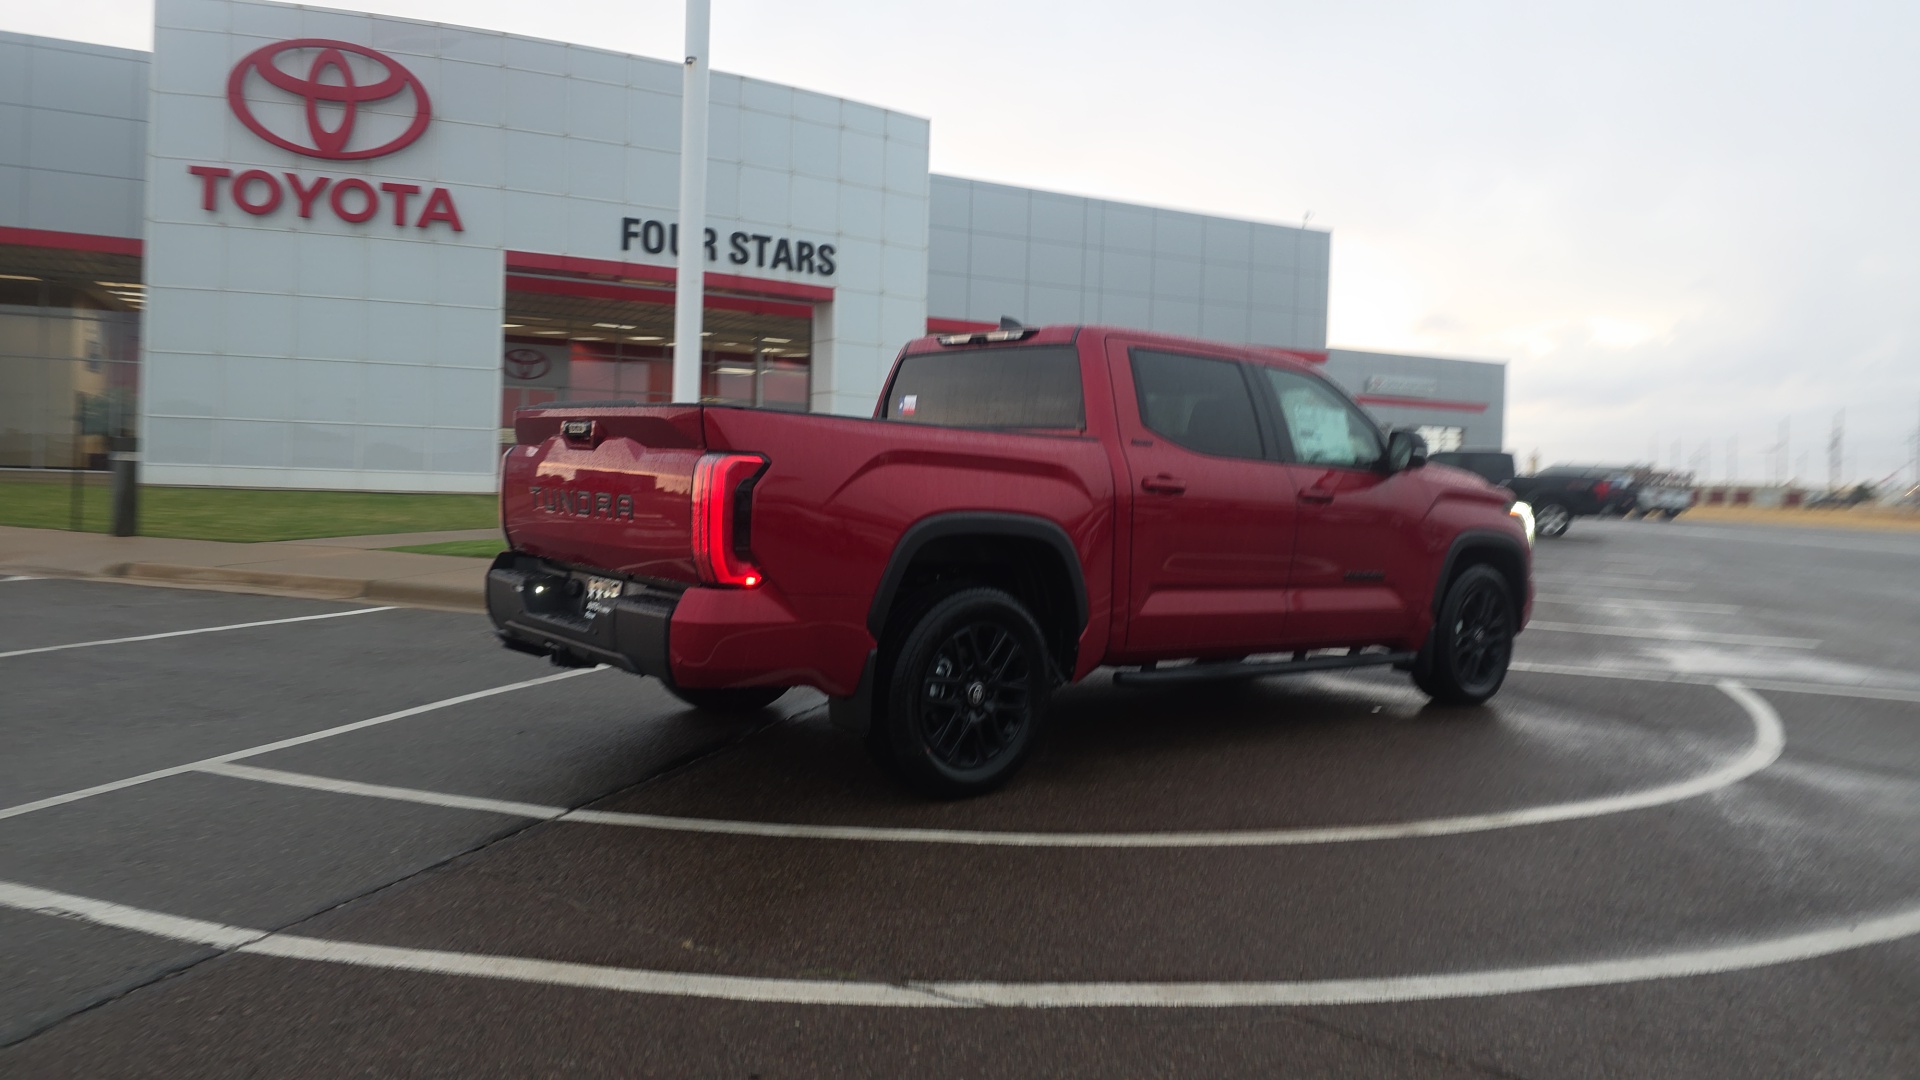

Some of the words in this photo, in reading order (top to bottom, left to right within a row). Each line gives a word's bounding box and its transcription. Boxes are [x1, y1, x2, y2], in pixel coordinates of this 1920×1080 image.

[187, 165, 464, 232] TOYOTA
[729, 231, 837, 276] STARS
[529, 486, 635, 521] TUNDRA
